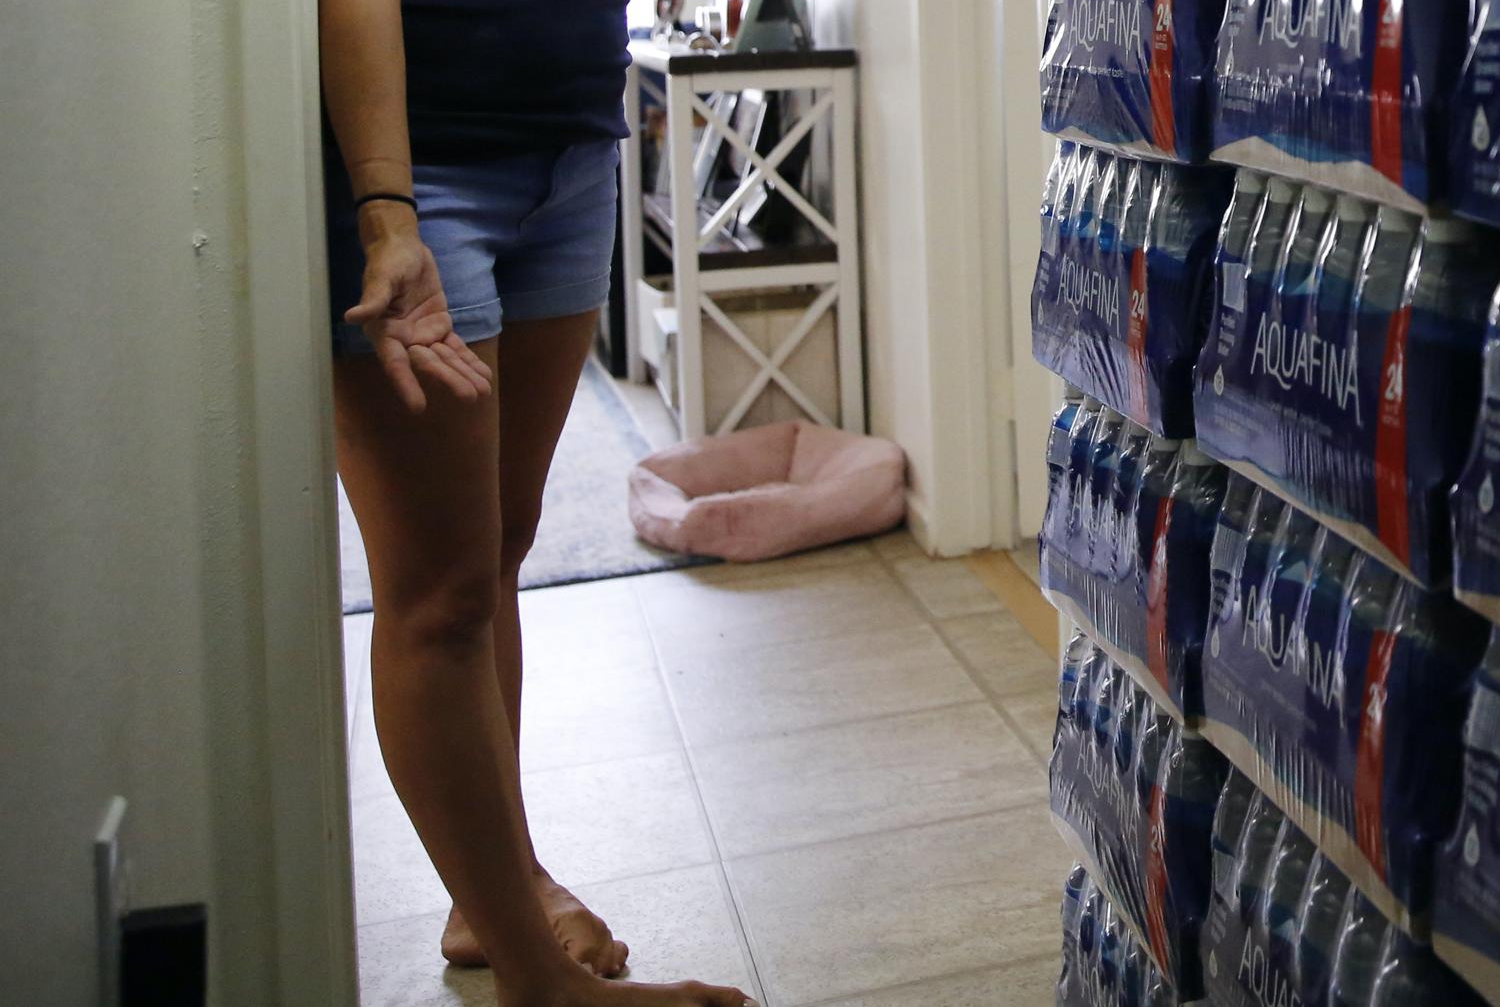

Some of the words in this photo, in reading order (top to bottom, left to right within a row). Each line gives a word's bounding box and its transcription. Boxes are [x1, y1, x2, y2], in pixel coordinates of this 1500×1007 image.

[1156, 3, 1171, 32] 24
[1057, 253, 1121, 338] AQUAFINA
[1132, 289, 1145, 321] 24
[1250, 311, 1363, 427] AQUAFINA
[1384, 359, 1403, 402] 24
[1238, 926, 1304, 1007] AQUA
